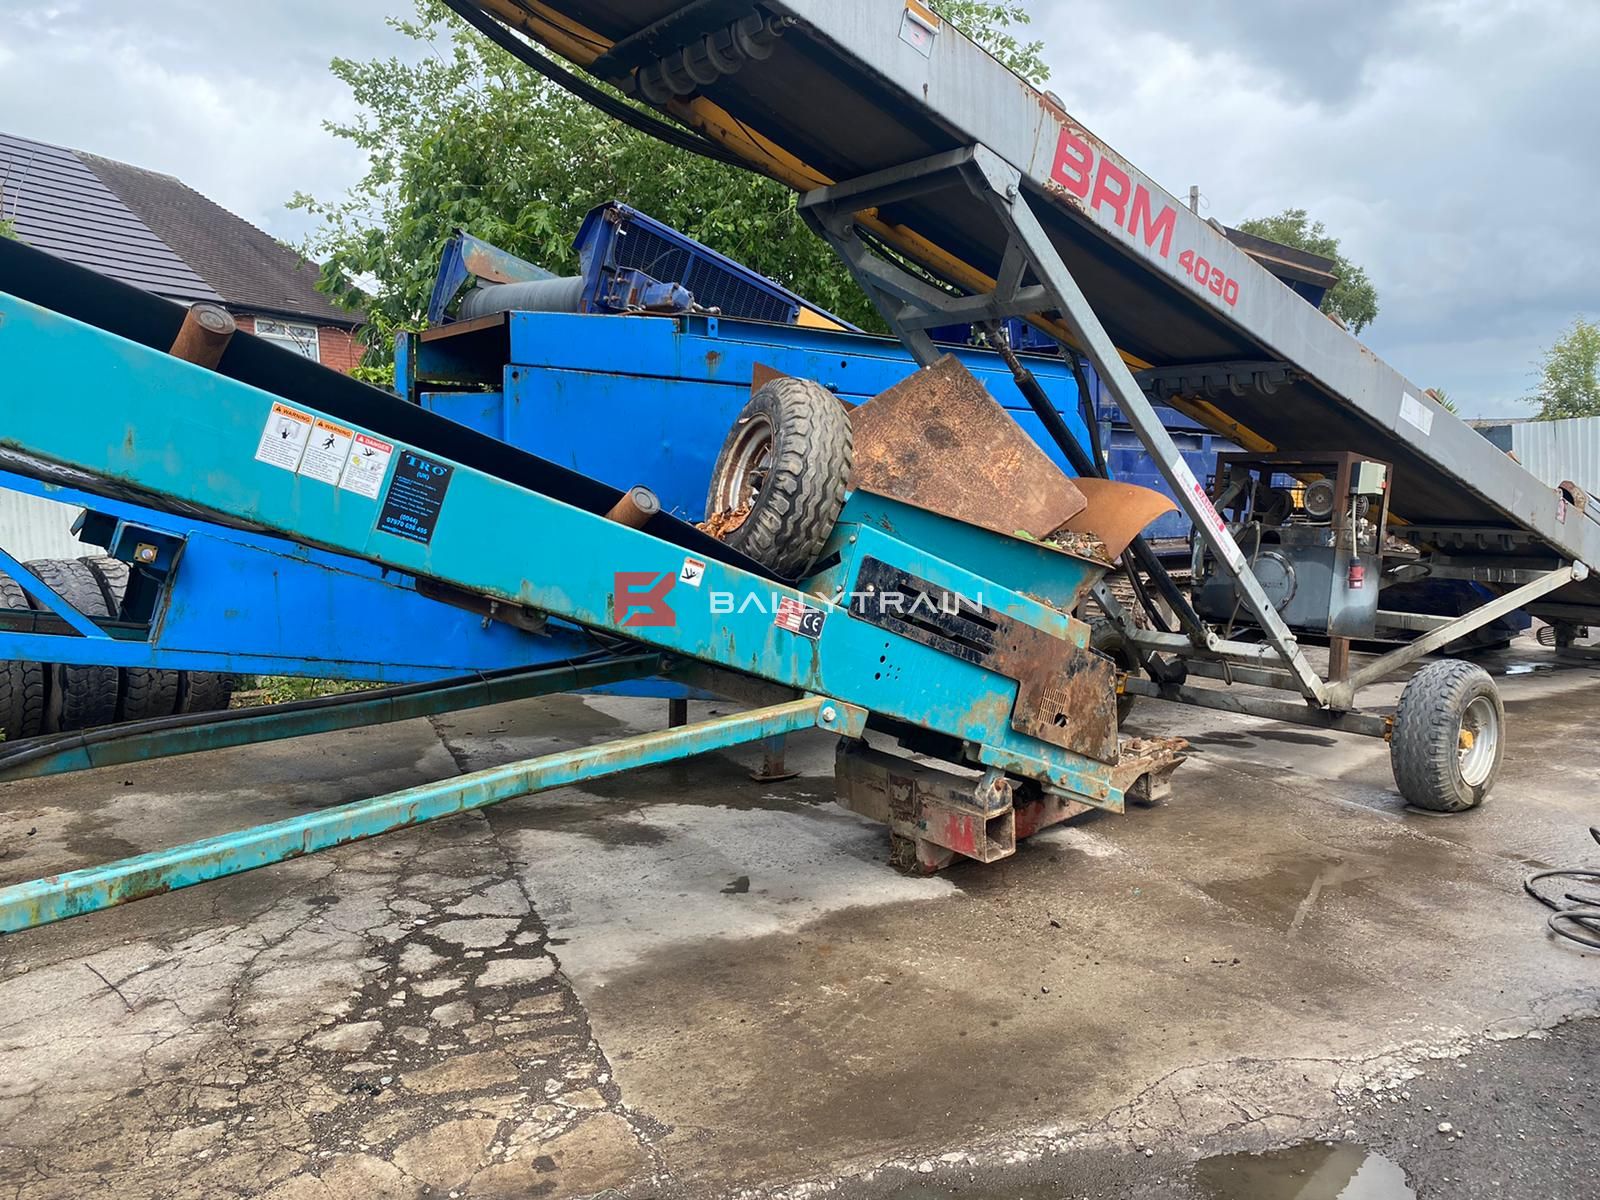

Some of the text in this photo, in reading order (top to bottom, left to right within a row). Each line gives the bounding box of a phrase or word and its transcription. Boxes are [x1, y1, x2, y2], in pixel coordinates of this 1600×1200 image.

[1050, 126, 1240, 307] BRM 4030
[283, 405, 311, 423] WARNING
[324, 423, 351, 438] WARNING
[365, 435, 390, 452] DANGER
